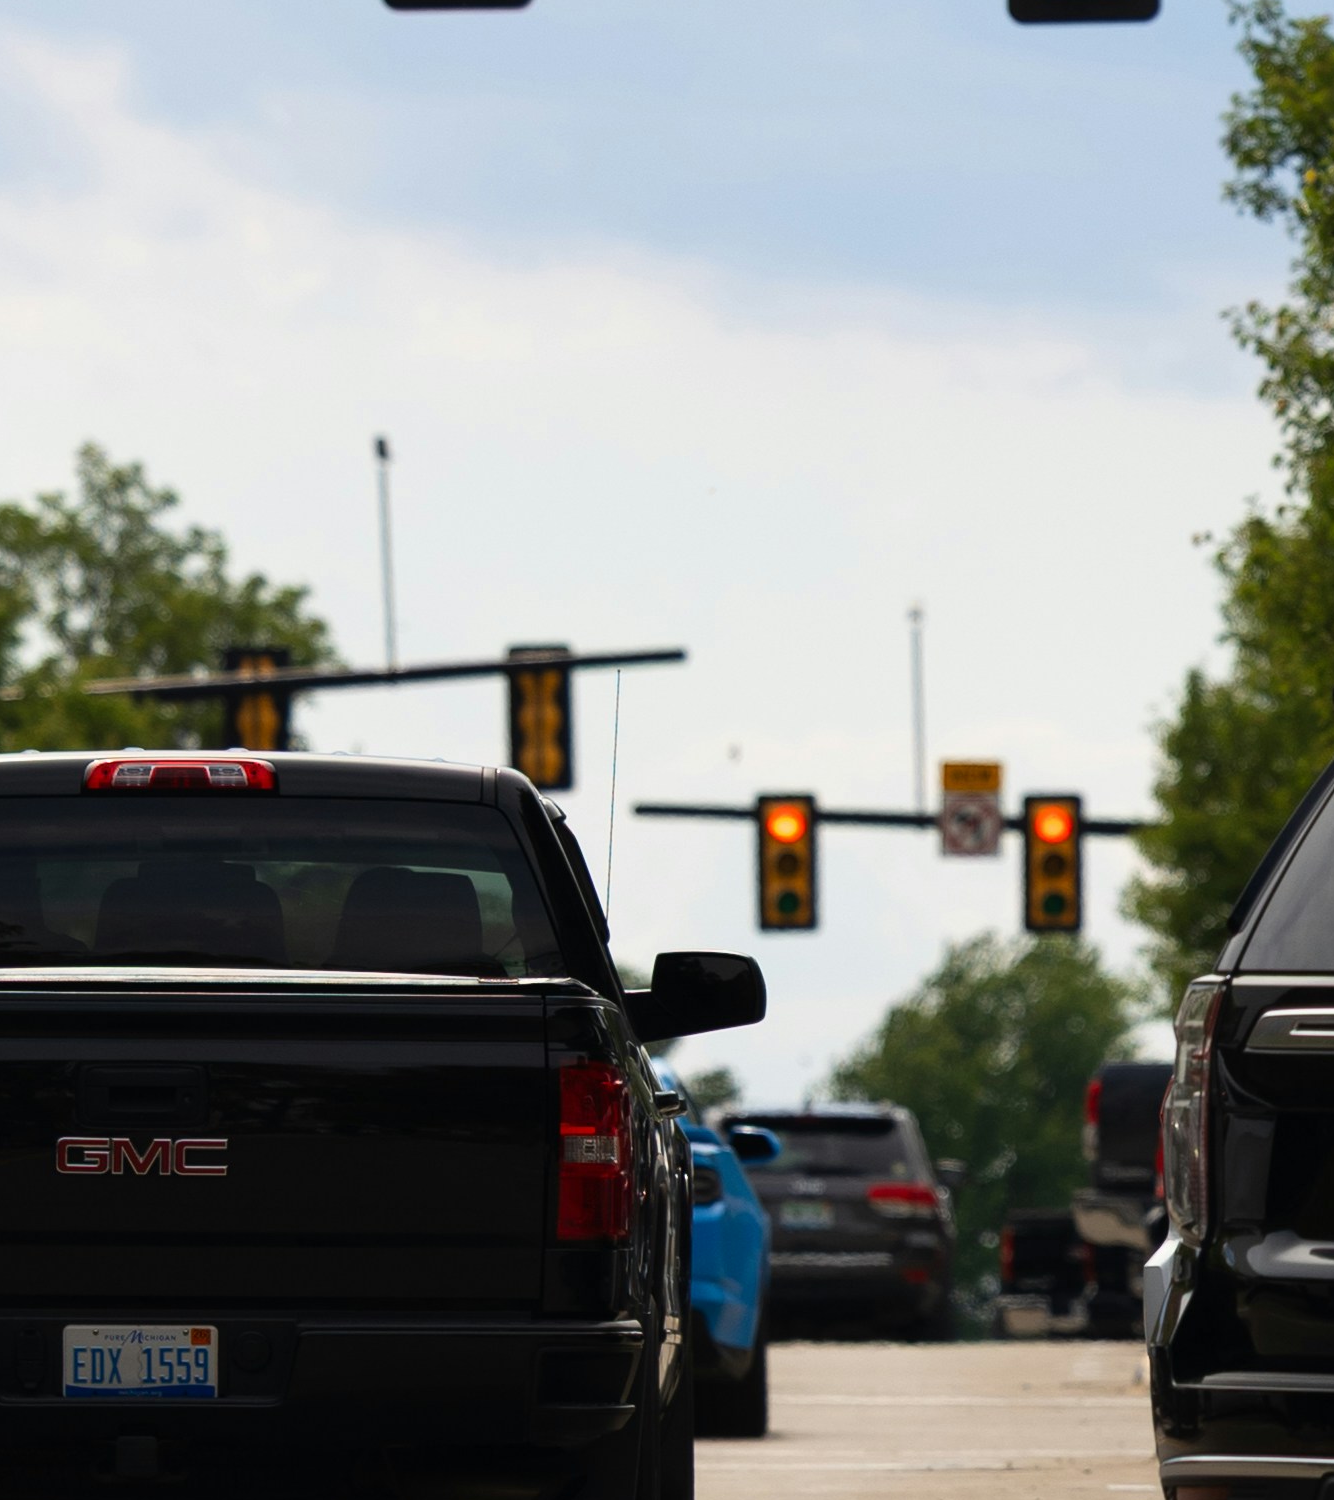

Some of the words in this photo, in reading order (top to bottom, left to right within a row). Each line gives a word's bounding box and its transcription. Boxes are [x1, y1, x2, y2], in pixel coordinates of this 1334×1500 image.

[56, 1136, 228, 1176] GMC
[73, 1347, 122, 1384] EDX
[142, 1347, 209, 1384] 1559
